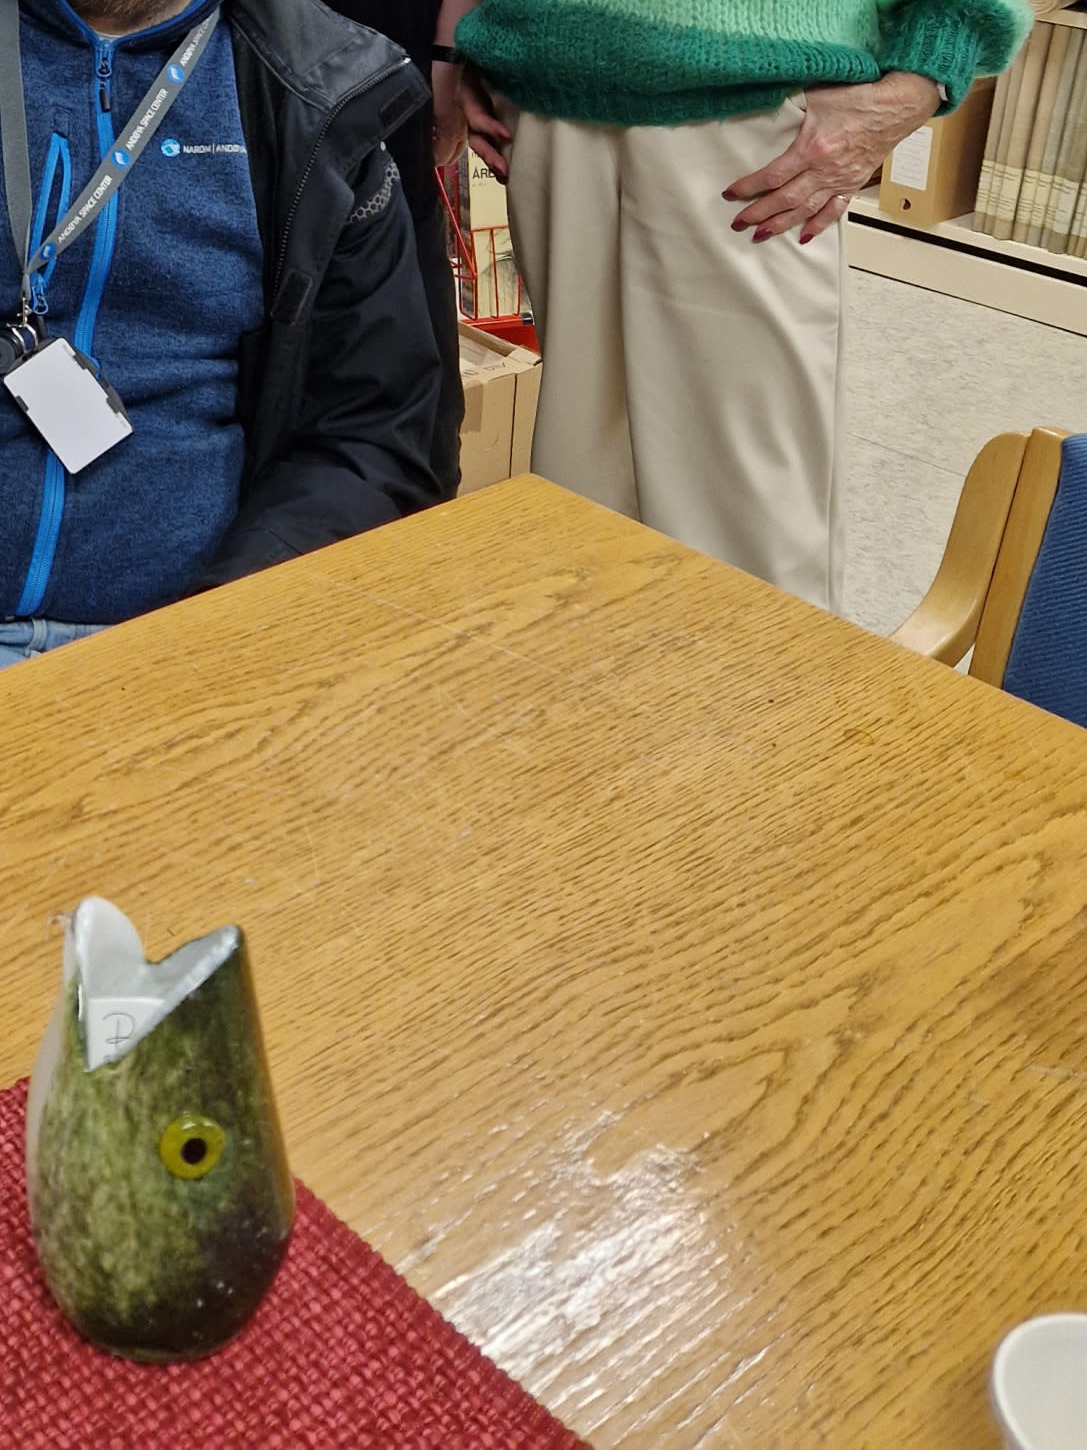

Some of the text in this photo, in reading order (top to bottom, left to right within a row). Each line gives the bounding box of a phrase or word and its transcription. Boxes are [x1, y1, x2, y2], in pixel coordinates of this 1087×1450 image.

[139, 108, 156, 127] SPACE
[150, 88, 168, 110] CENTER
[58, 175, 112, 243] ANDØYA SPACE CENTER
